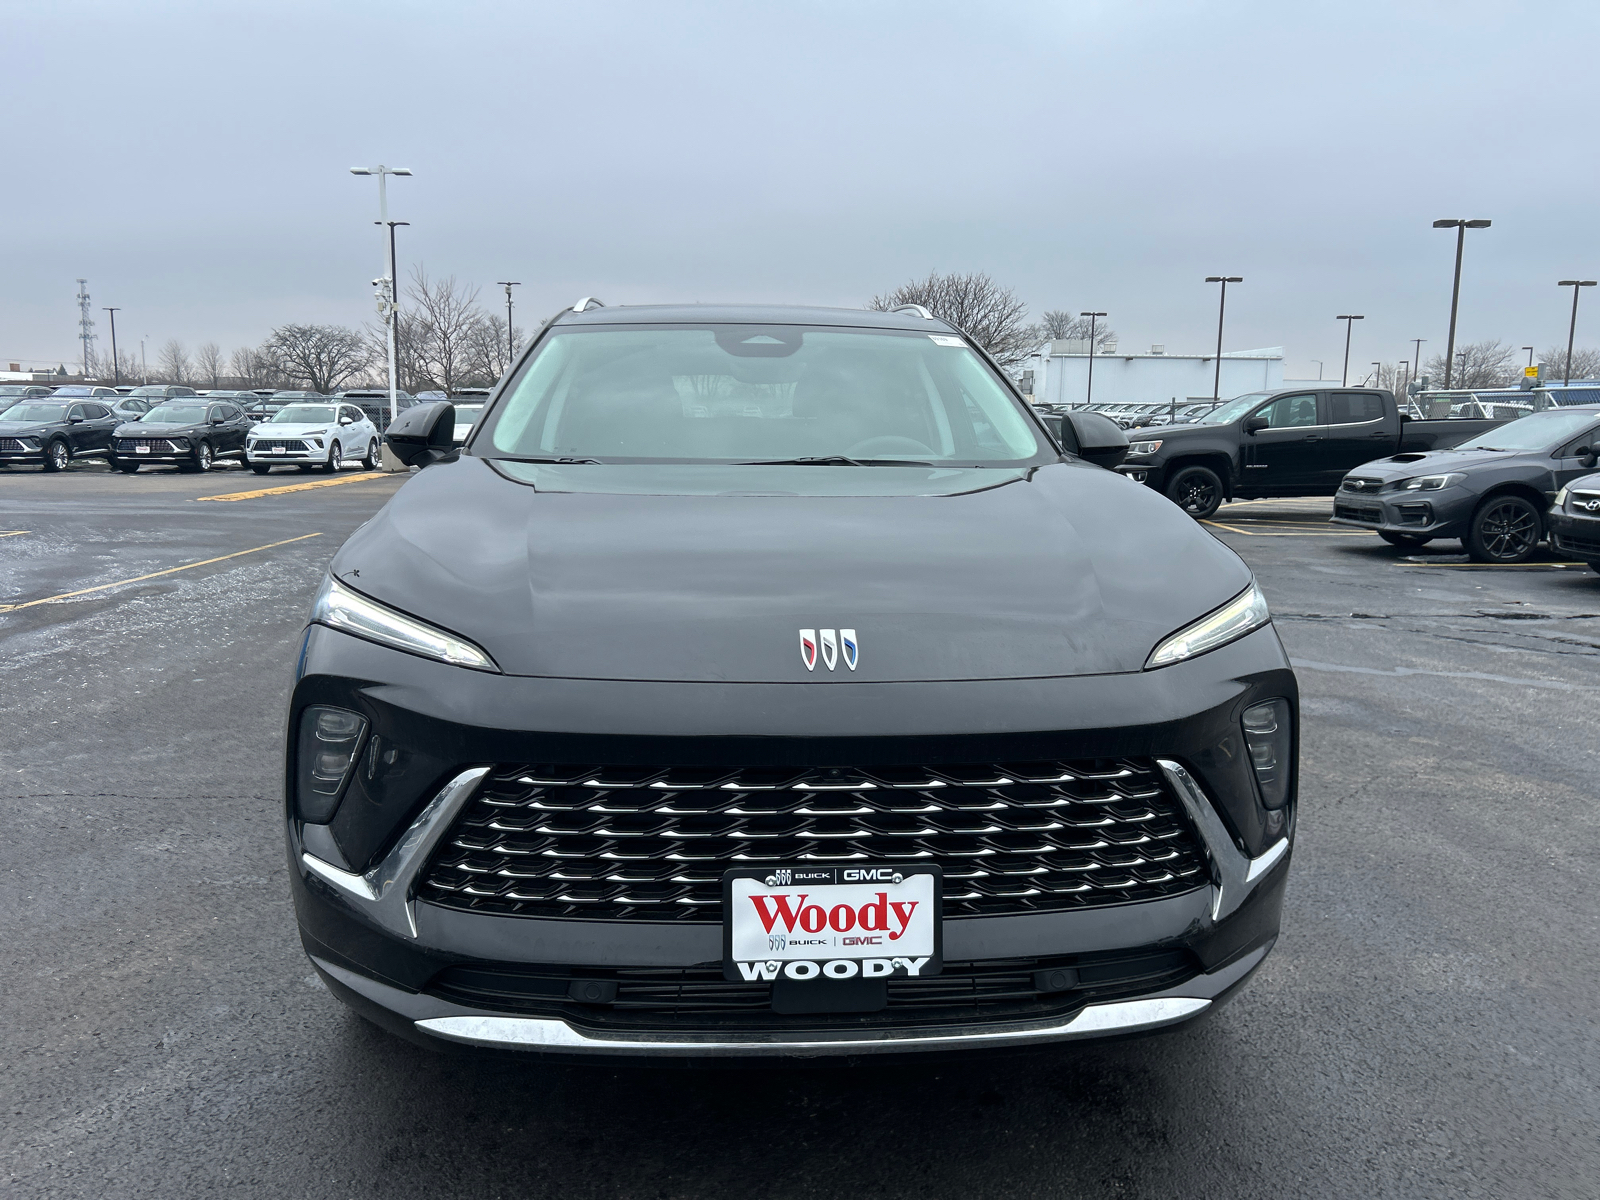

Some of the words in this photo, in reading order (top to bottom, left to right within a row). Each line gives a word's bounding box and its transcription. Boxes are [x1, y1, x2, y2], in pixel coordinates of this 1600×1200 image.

[843, 868, 893, 881] GMC
[748, 892, 919, 941] Woody
[842, 936, 882, 946] GMC
[736, 957, 931, 981] WOODY
